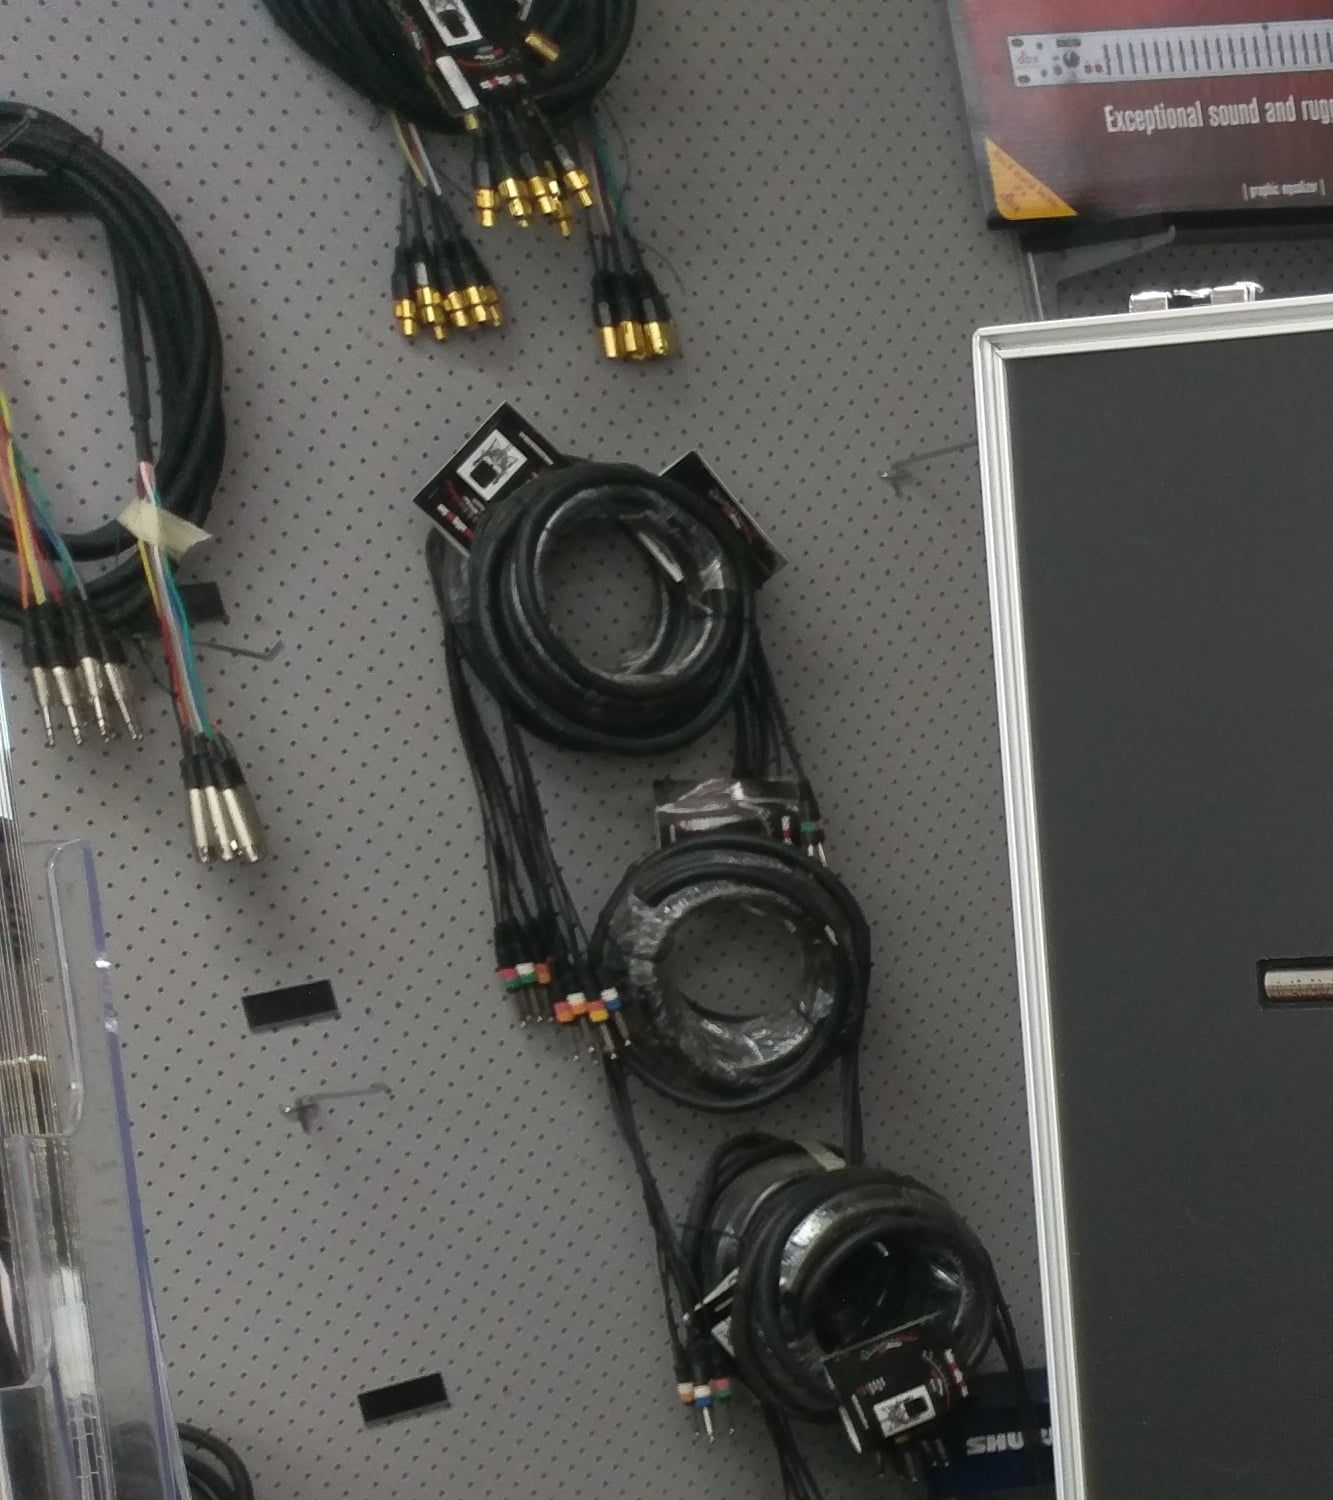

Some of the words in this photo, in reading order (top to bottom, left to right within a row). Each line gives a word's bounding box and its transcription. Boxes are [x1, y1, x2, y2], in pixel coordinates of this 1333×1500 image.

[1104, 100, 1204, 135] Exceptional
[1208, 97, 1260, 128] sound
[1265, 94, 1297, 124] and
